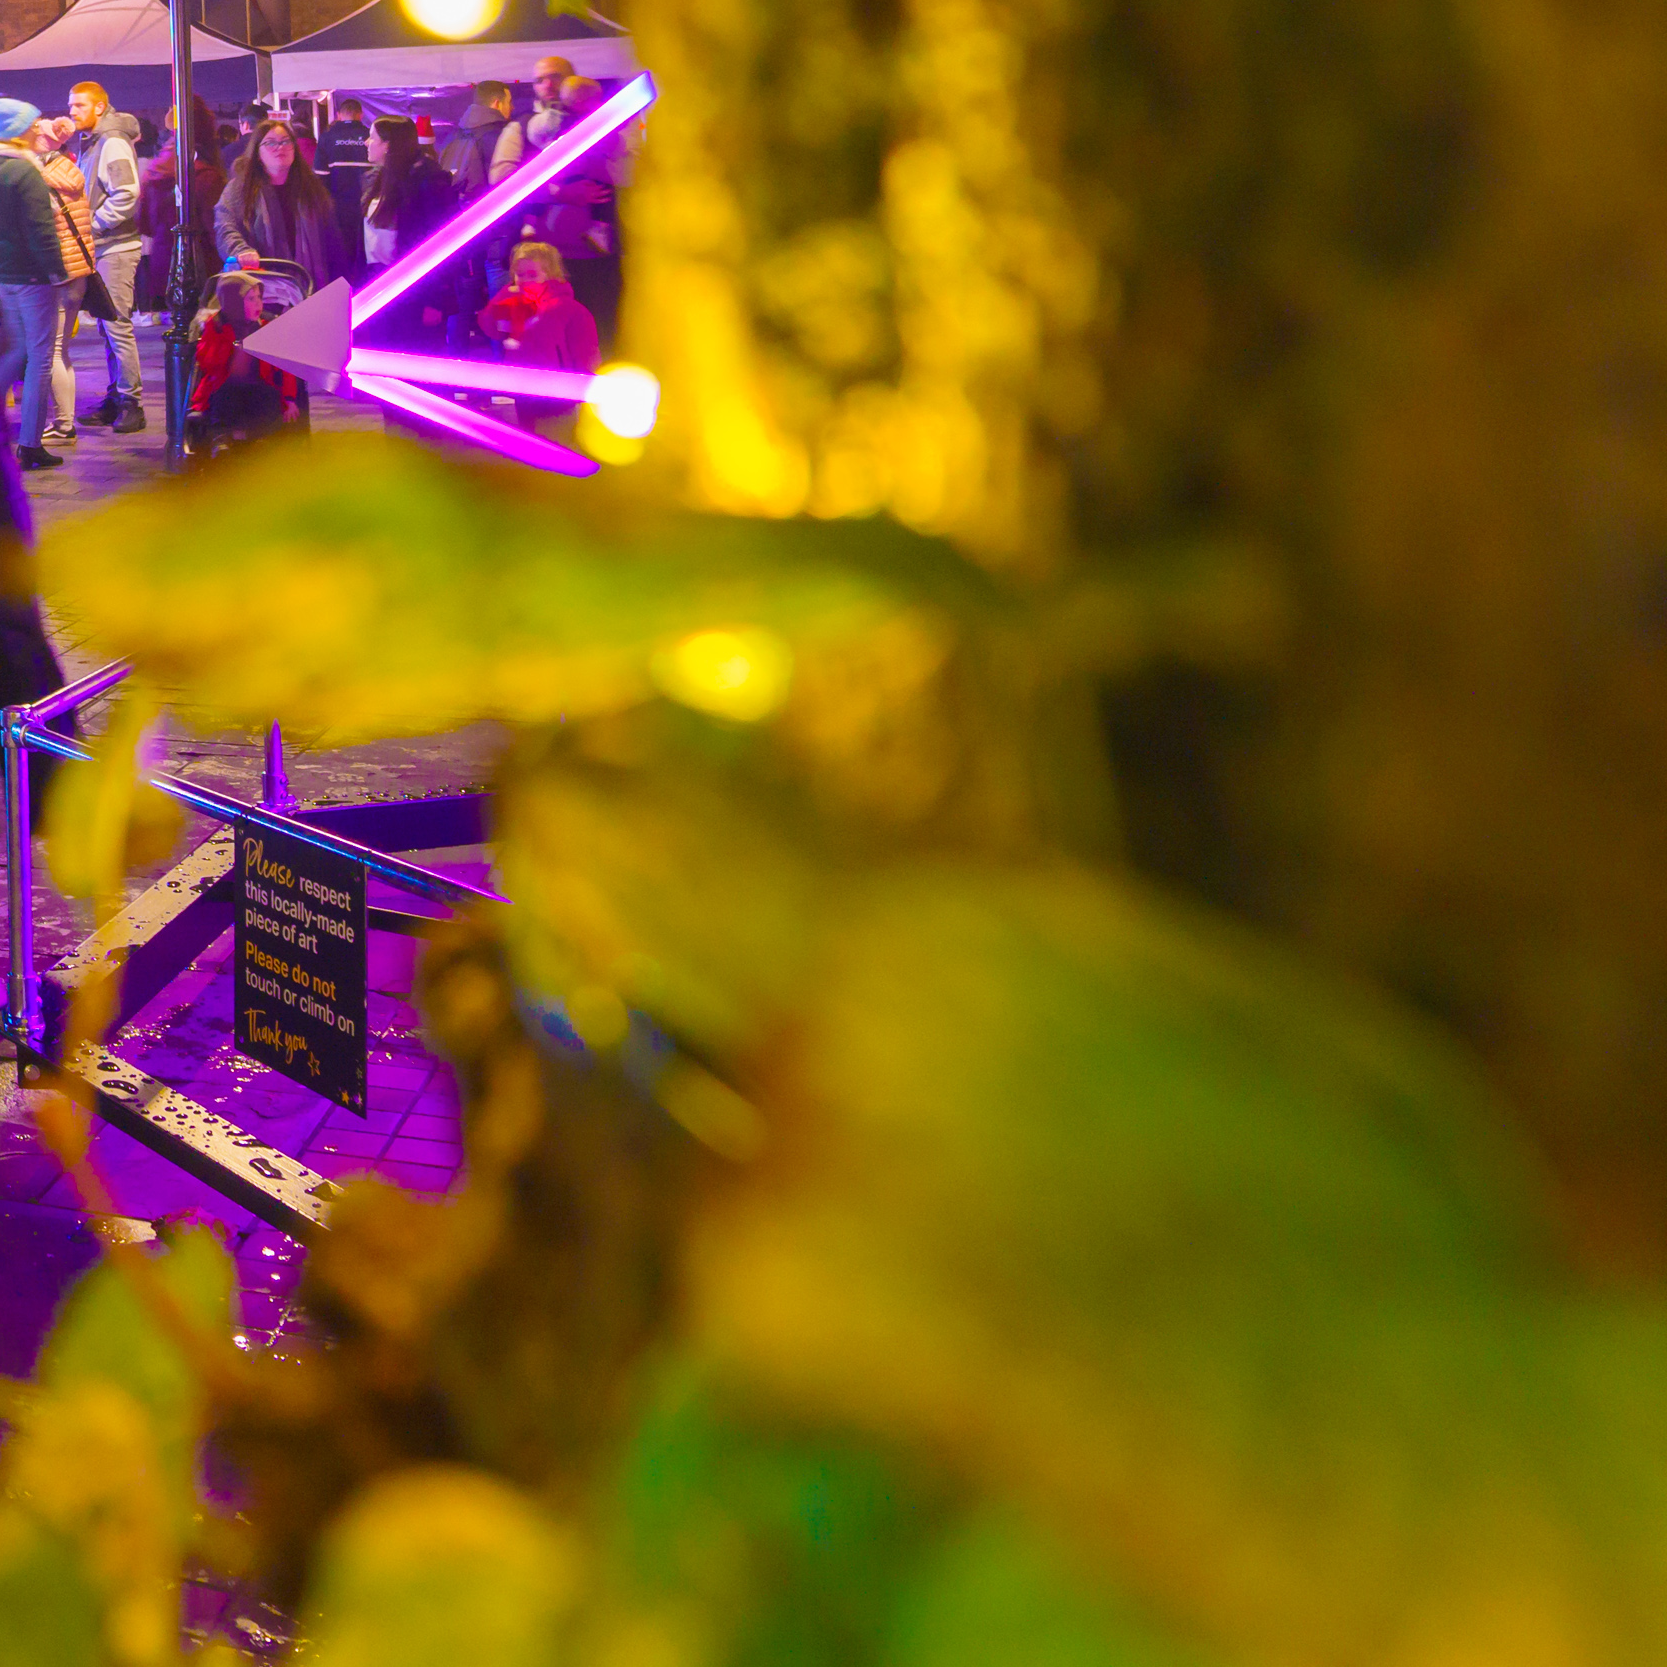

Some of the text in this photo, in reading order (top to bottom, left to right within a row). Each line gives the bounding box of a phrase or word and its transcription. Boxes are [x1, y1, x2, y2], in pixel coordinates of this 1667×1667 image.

[243, 837, 352, 912] Please respect
[245, 880, 355, 944] this locally-made
[245, 907, 319, 955] piece of art
[245, 967, 356, 1037] touch or climb on
[246, 940, 337, 1002] Please do not
[244, 1007, 308, 1065] Thank you
